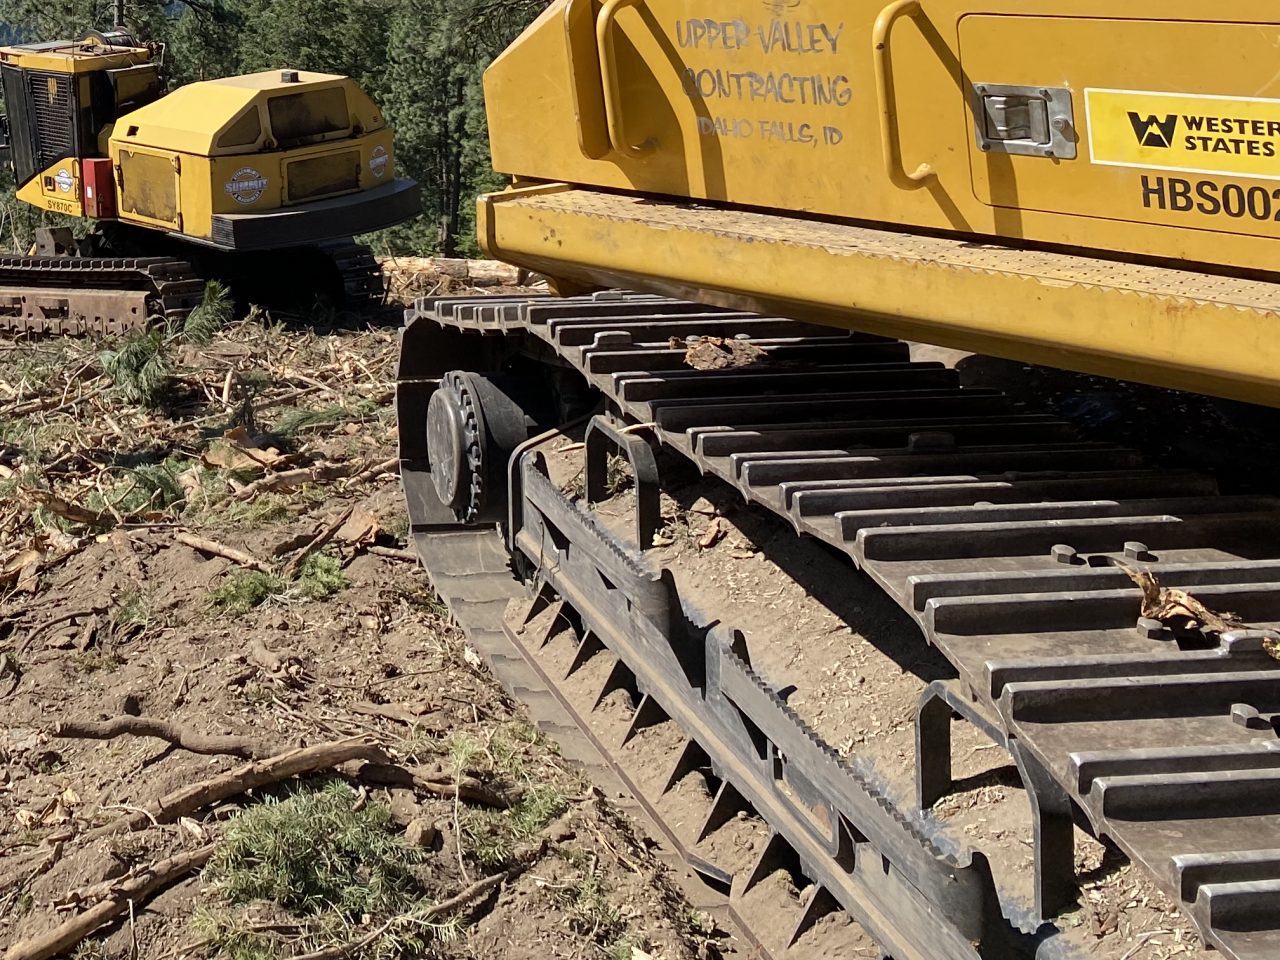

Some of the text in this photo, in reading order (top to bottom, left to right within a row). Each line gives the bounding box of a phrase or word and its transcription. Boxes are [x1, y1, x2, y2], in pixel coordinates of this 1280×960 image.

[676, 19, 844, 54] UPPER VALLEY
[682, 67, 853, 107] CONTRACTING
[823, 126, 843, 145] ID
[1185, 136, 1276, 157] STATES
